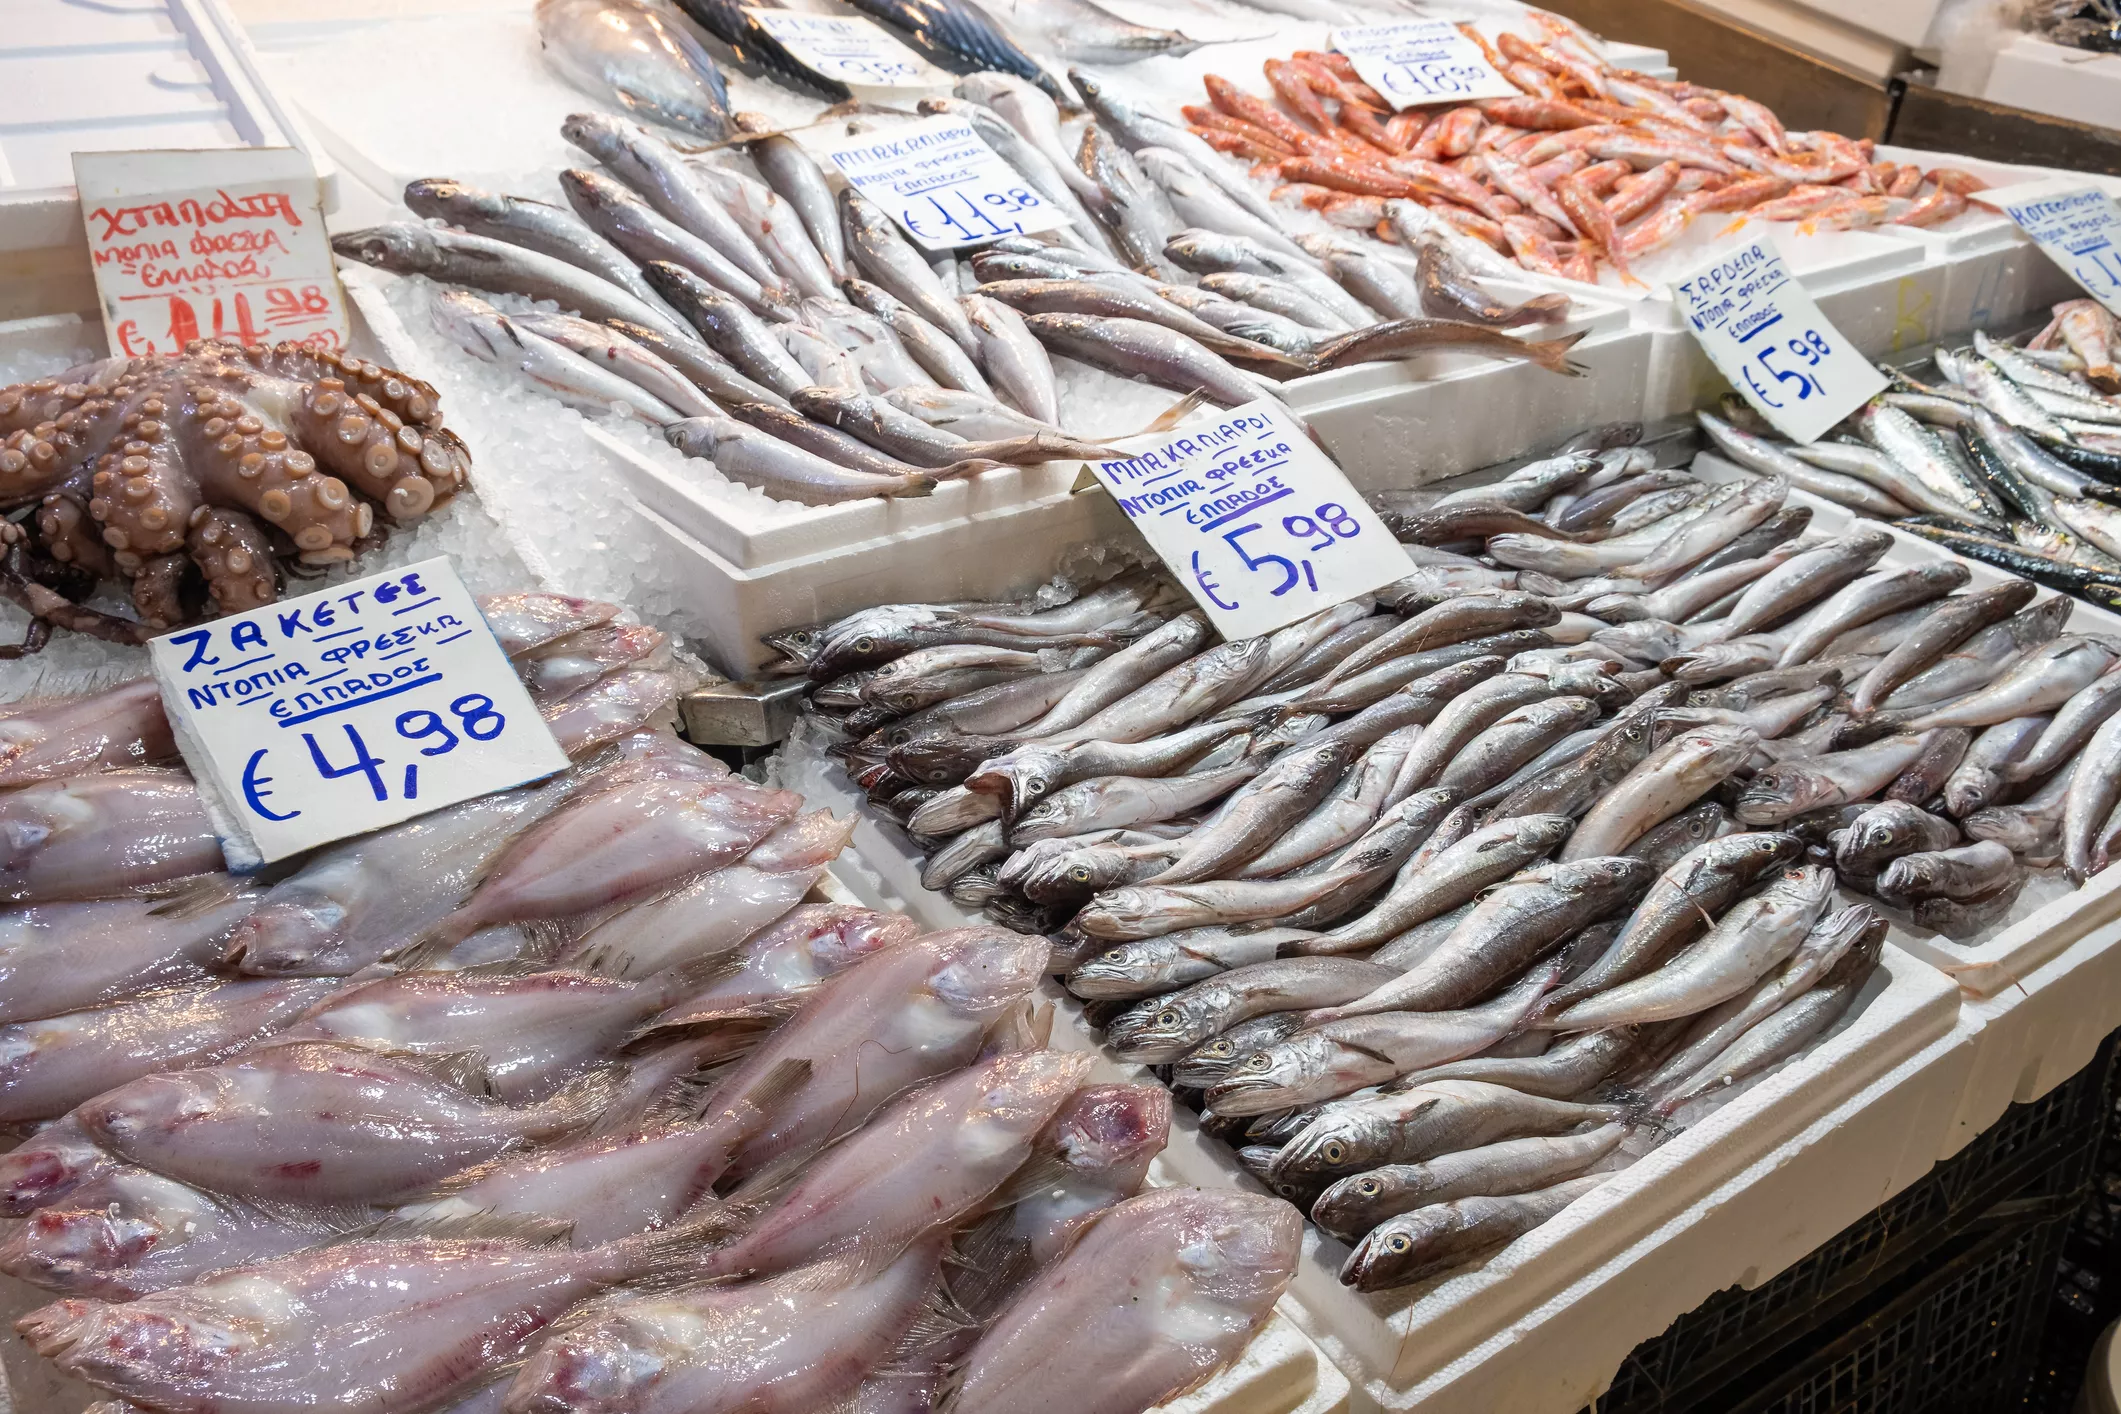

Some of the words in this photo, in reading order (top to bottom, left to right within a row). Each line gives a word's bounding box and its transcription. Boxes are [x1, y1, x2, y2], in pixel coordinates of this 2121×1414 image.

[1118, 479, 1206, 518] ΝΤΟΠΙΑ
[1205, 442, 1293, 482] ΦΡΕΣΚΑ
[186, 661, 310, 711] ΝΤΟΠΙΑ
[320, 614, 463, 664] ΦΡΕΣΚΑ
